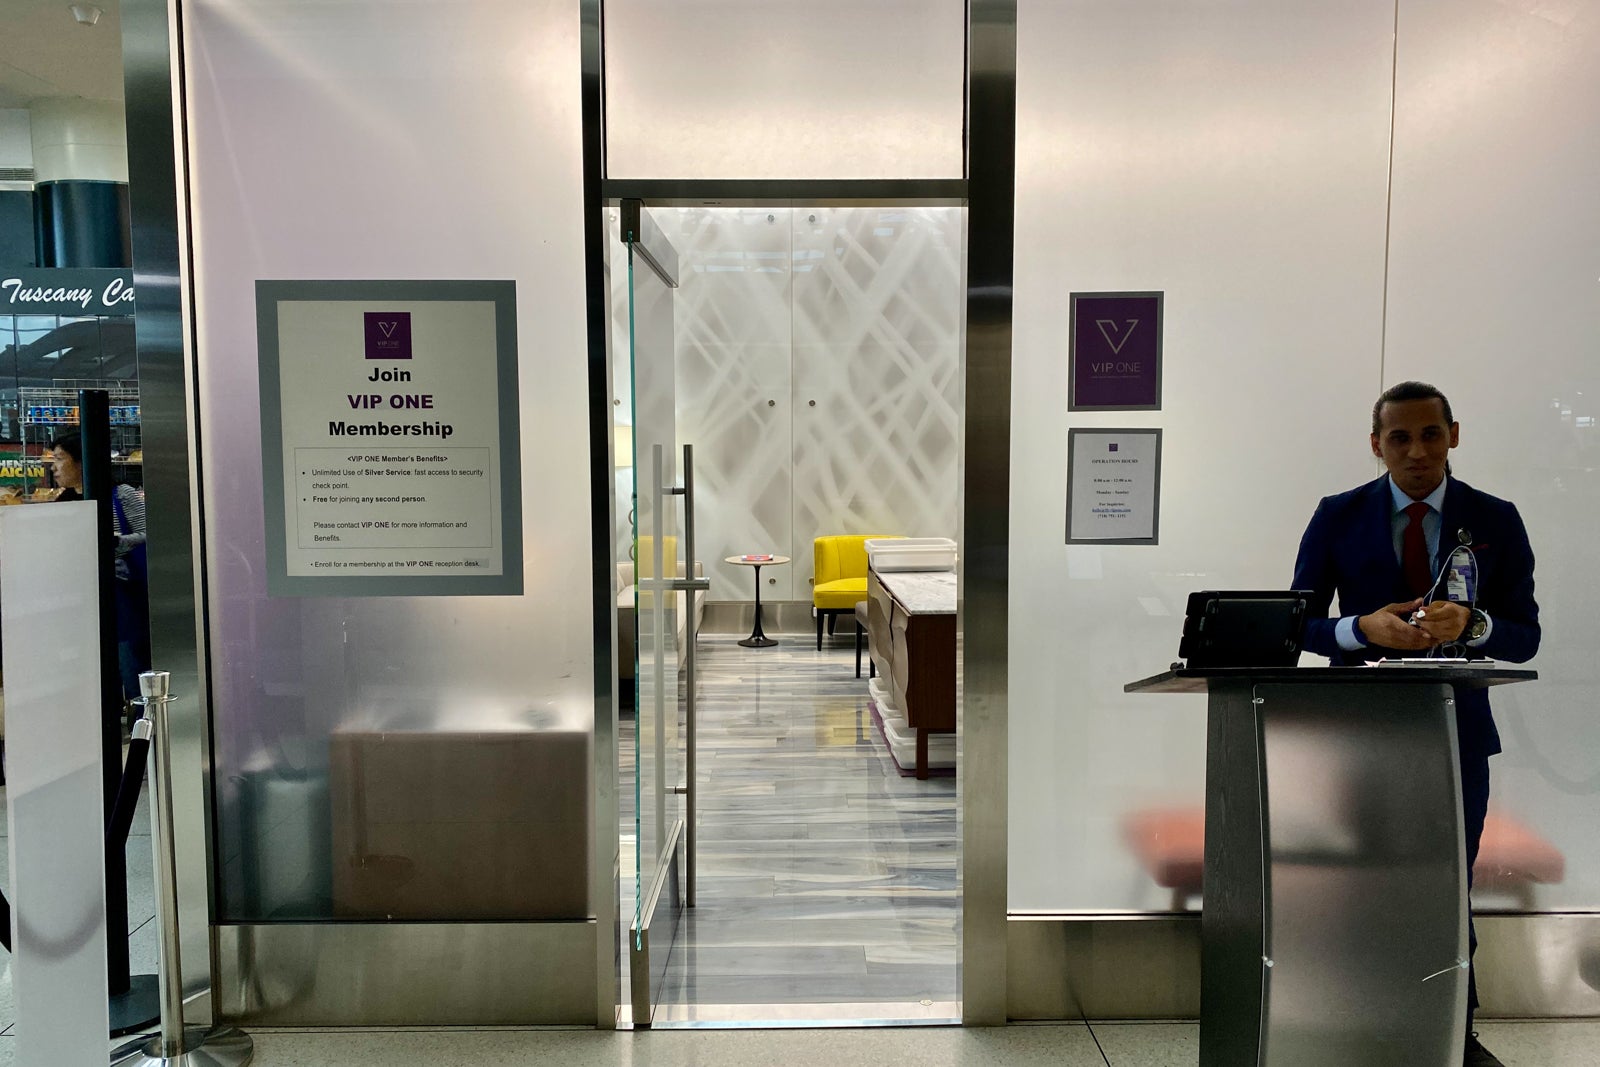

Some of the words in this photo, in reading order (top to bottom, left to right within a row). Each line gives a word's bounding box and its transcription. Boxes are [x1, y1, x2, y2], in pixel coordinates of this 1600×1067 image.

[2, 278, 93, 309] Tuscany
[1091, 362, 1114, 373] VIP
[1116, 362, 1141, 373] ONE
[368, 367, 412, 382] Join
[347, 394, 383, 409] VIP
[389, 394, 434, 409] ONE
[329, 421, 453, 440] Membership
[364, 455, 380, 463] ONE
[381, 455, 415, 463] Member's
[416, 455, 448, 463] Benefits>
[364, 468, 384, 476] Silver
[414, 468, 427, 476] fast
[458, 468, 484, 477] security
[332, 482, 350, 491] point.
[312, 495, 328, 503] Free
[329, 495, 338, 503] for
[338, 495, 360, 504] joining
[361, 496, 374, 504] any
[375, 495, 400, 503] second
[313, 521, 336, 529] Please
[336, 521, 360, 529] contact
[418, 521, 454, 529] information
[314, 534, 341, 542] Benefits.
[348, 561, 386, 569] membership
[394, 560, 405, 568] the
[405, 560, 418, 568] VIP
[418, 560, 434, 568] ONE
[434, 560, 464, 569] reception
